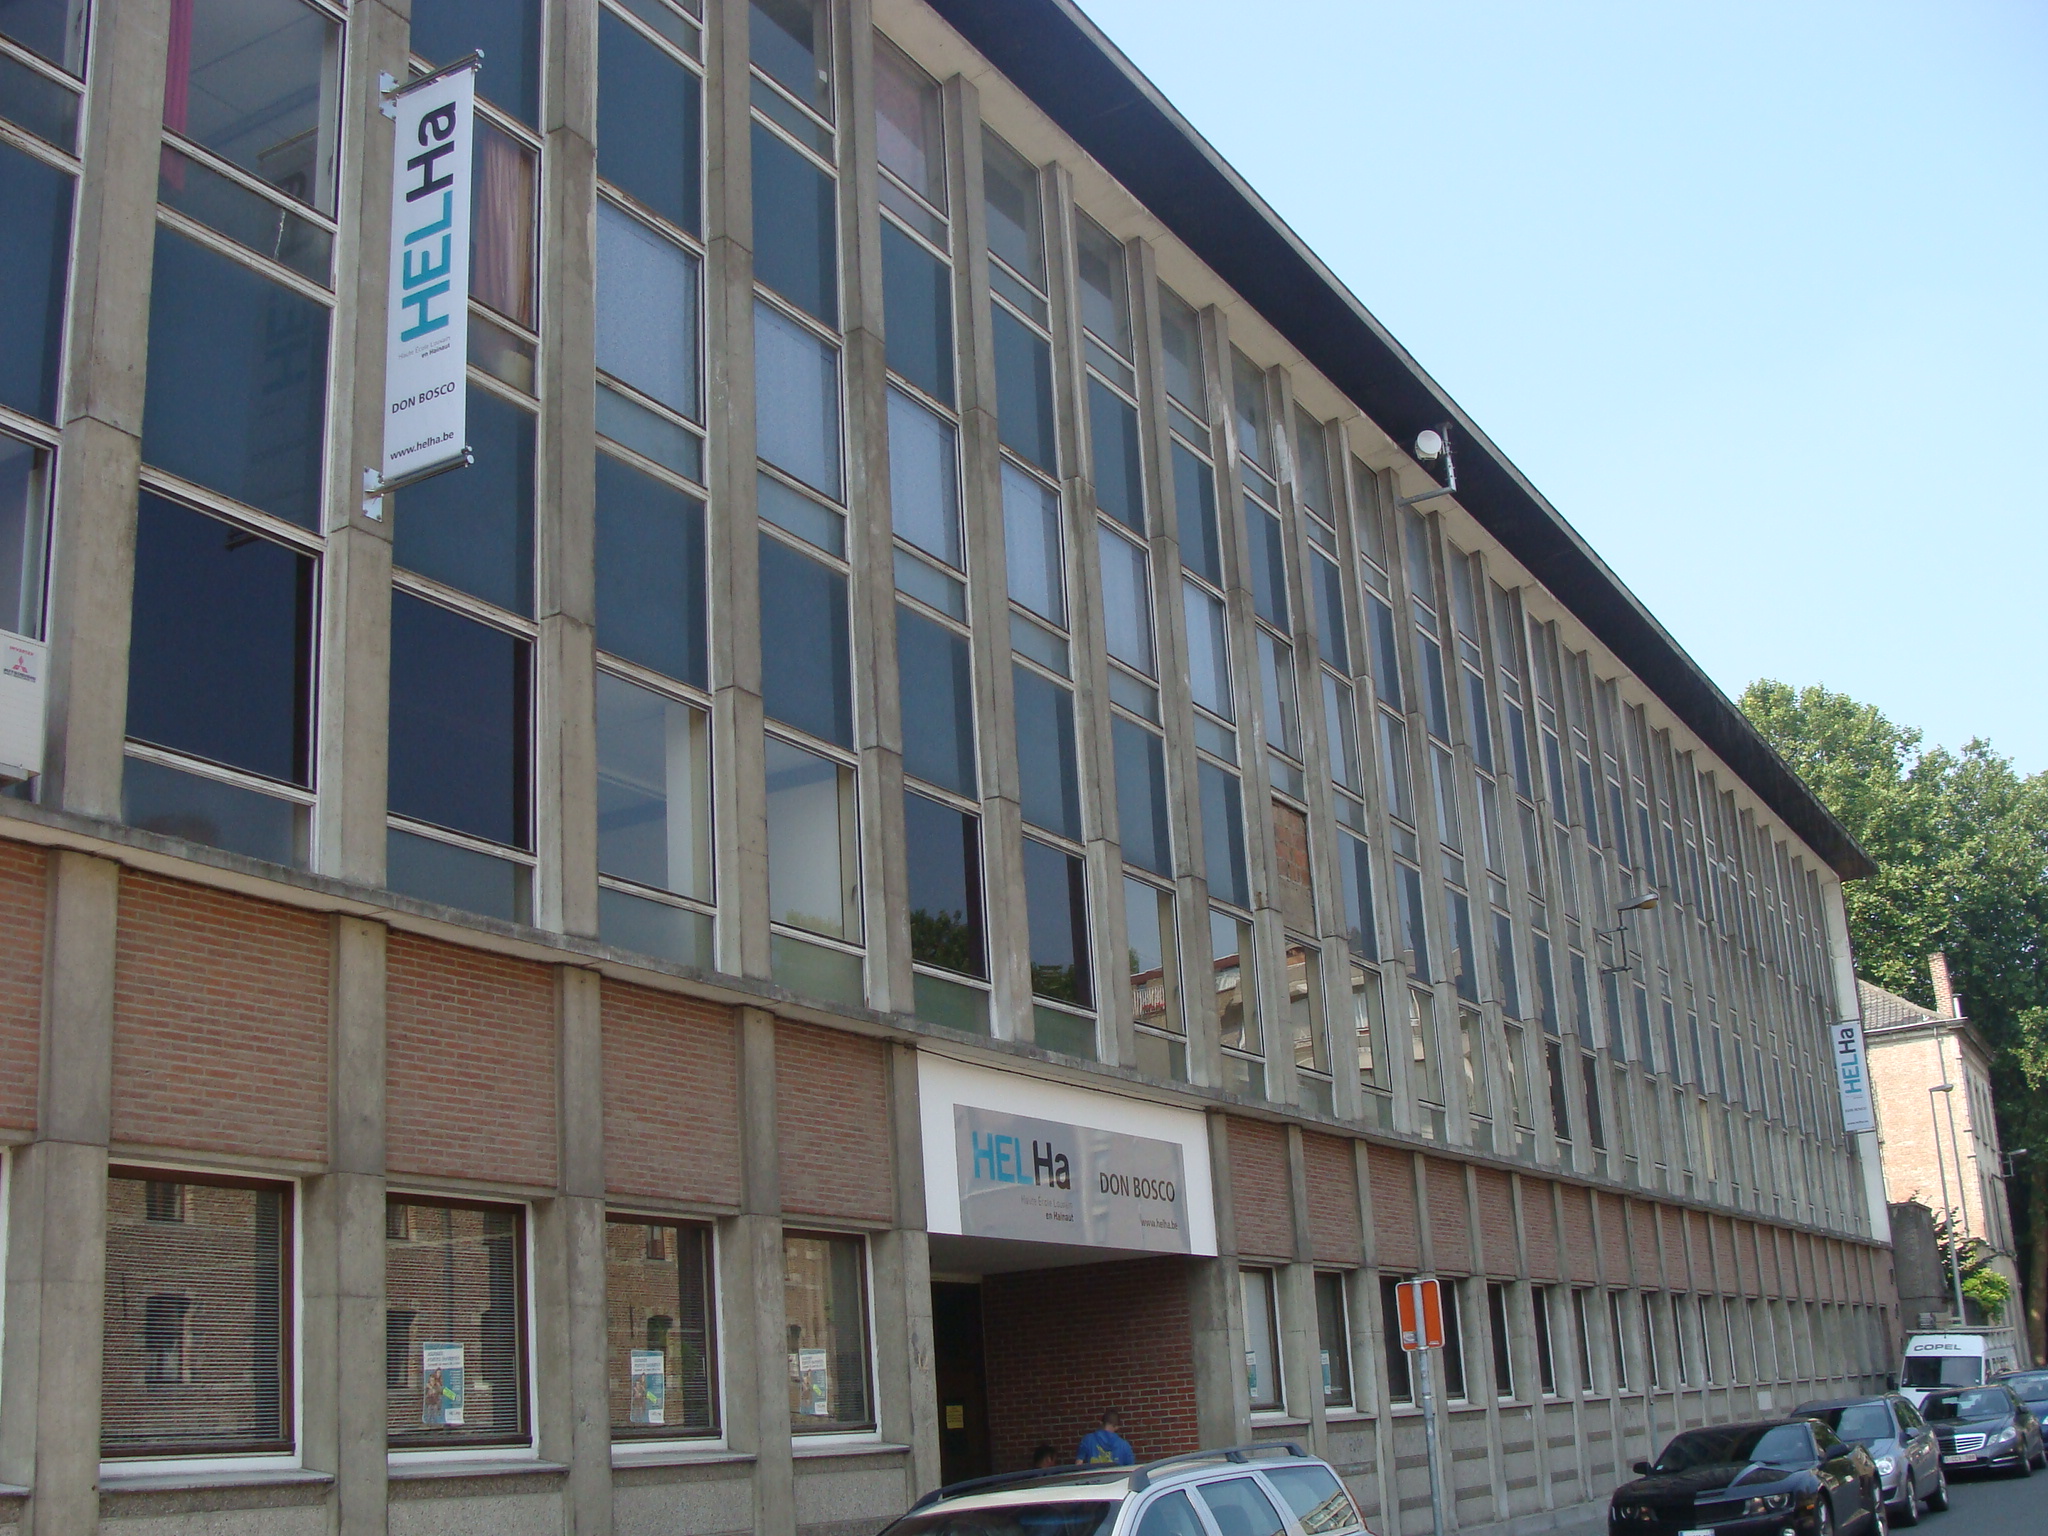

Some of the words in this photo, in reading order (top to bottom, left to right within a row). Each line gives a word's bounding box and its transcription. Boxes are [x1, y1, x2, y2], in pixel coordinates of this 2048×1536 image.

[401, 101, 457, 342] HELHa
[391, 396, 416, 414] DON
[418, 381, 456, 403] BOSCO
[390, 431, 454, 460] www.helha.be
[1838, 1028, 1862, 1094] HELHa
[971, 1131, 1070, 1190] HELHa
[1100, 1172, 1129, 1197] DON
[1133, 1177, 1175, 1202] BOSCO
[1141, 1218, 1178, 1230] www.helha.be
[1914, 1344, 1962, 1352] COPEL
